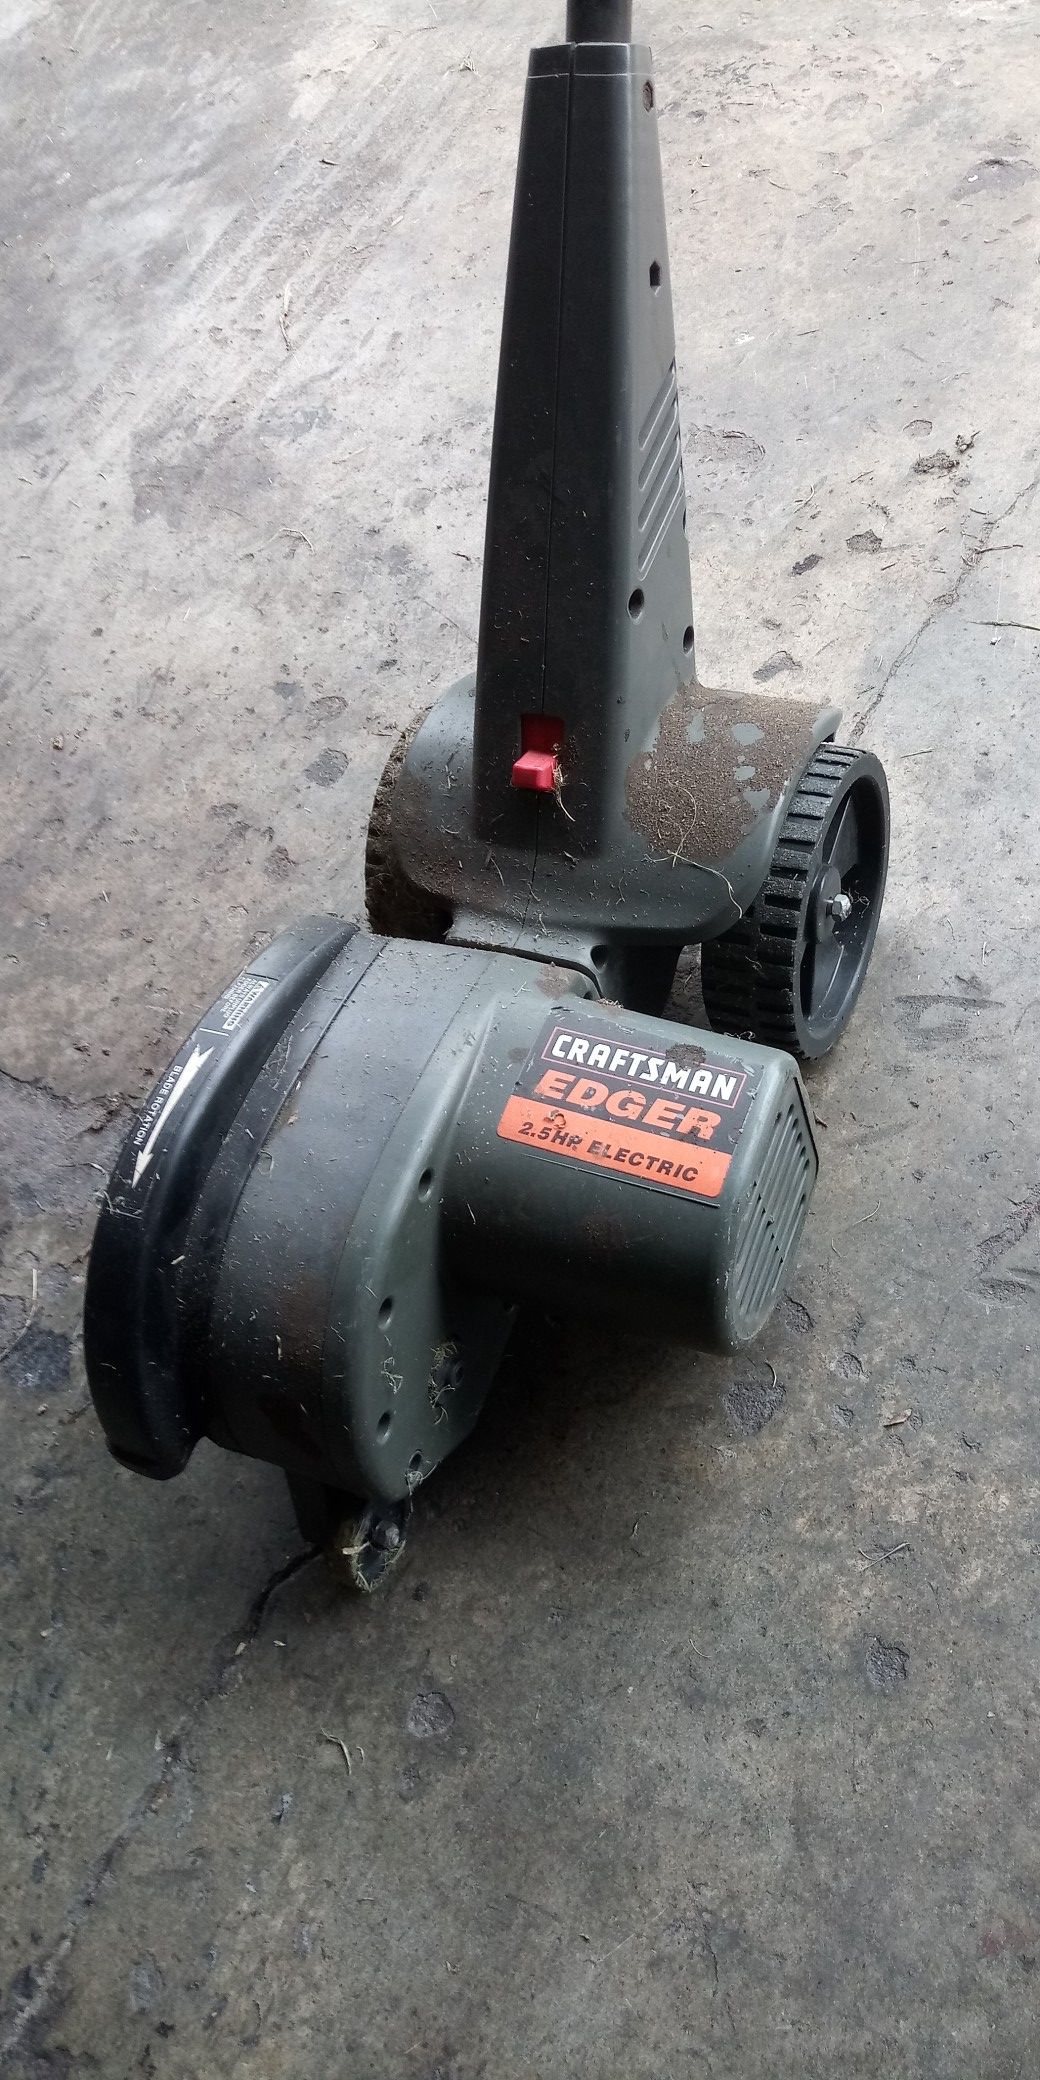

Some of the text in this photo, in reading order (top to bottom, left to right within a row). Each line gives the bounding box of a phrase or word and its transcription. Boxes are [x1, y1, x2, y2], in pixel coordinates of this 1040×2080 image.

[550, 1033, 738, 1101] CRAFTSMAN
[134, 1064, 183, 1146] BLADE ROTATION
[533, 1068, 723, 1141] EDGER
[587, 1139, 700, 1183] ELECTRIC
